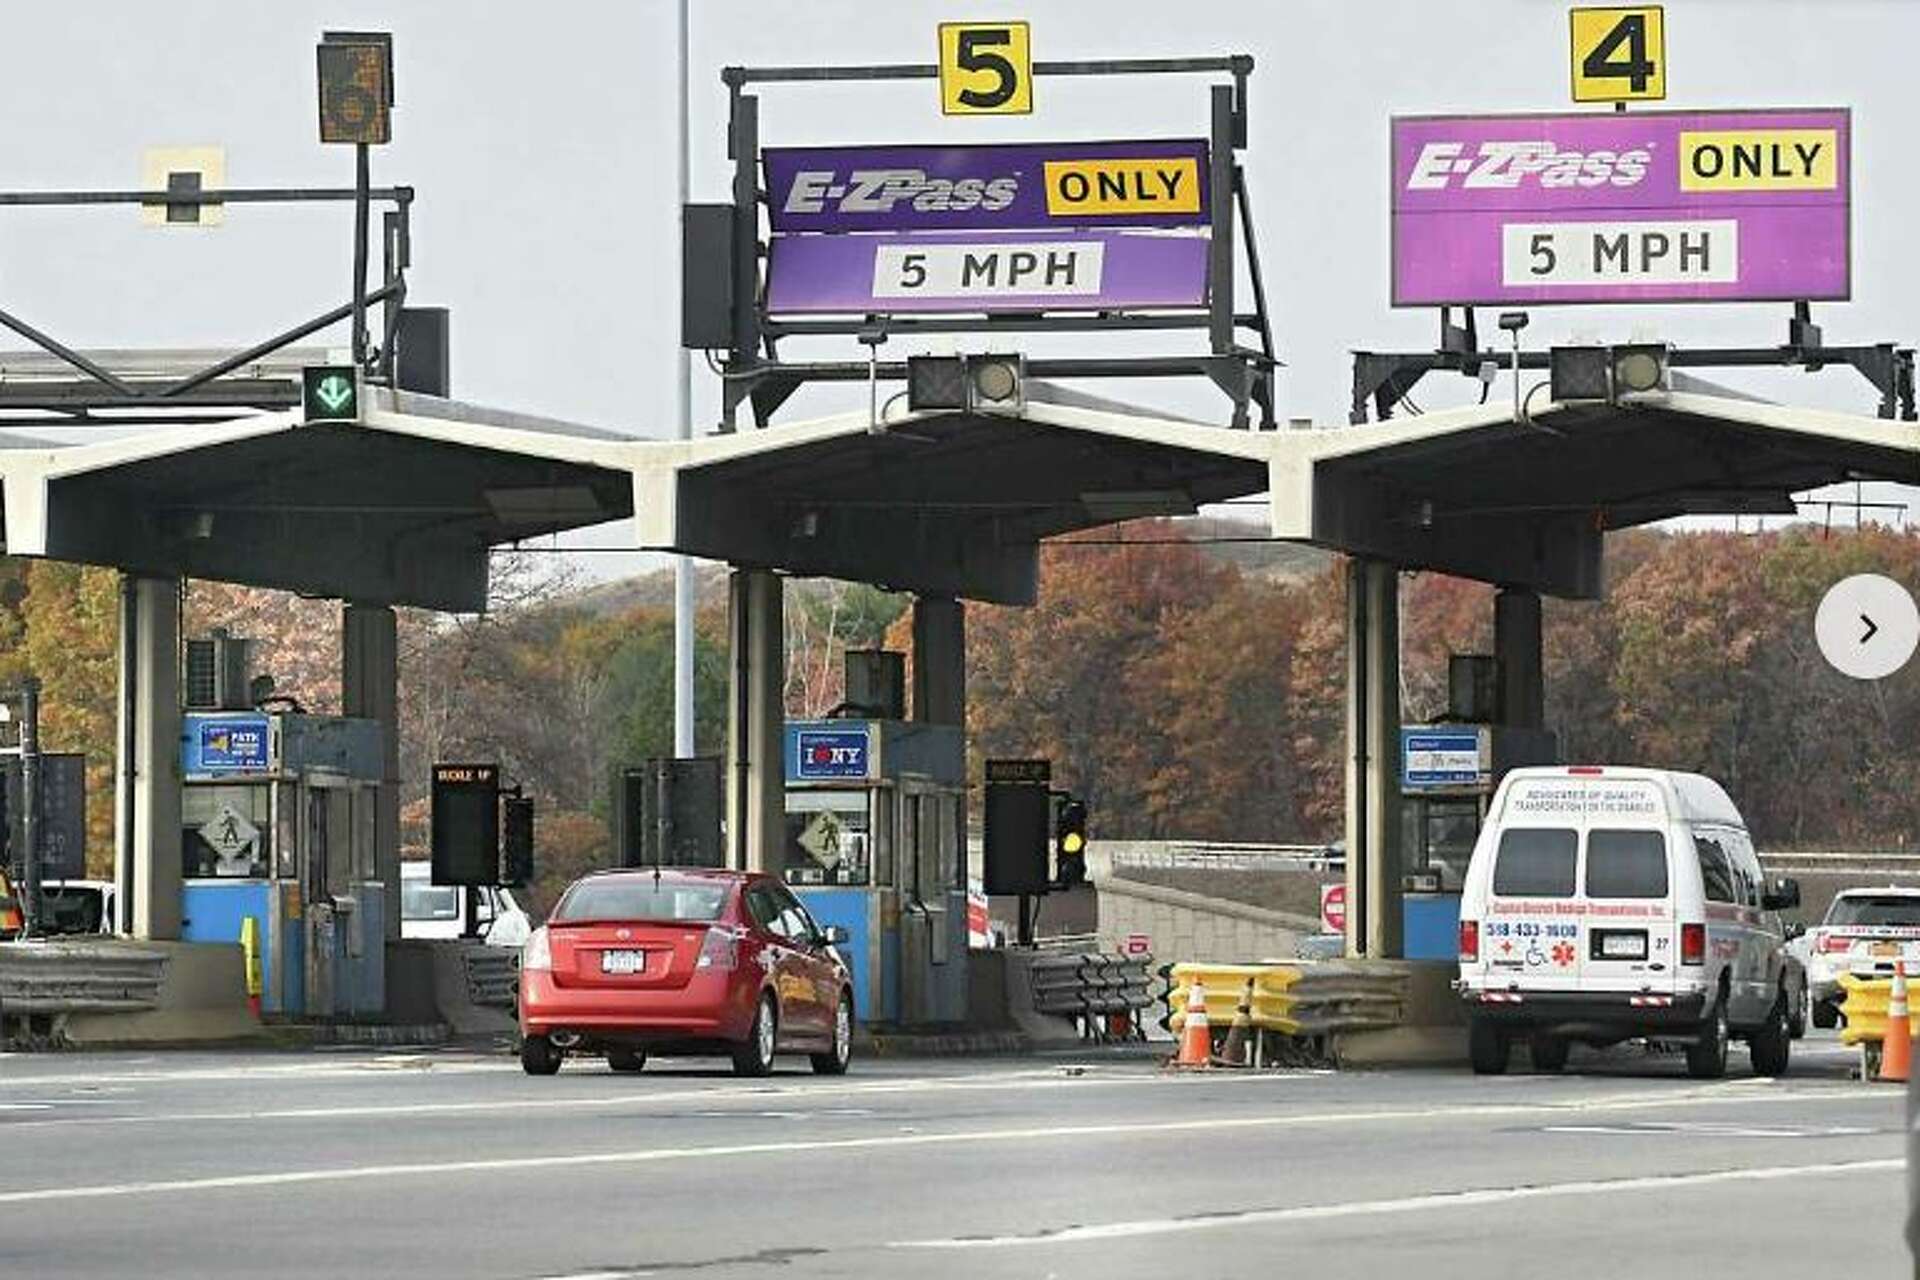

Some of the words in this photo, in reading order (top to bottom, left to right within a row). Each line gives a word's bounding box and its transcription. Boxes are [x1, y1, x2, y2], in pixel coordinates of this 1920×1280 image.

[957, 30, 1017, 108] 5
[1583, 15, 1655, 93] 4
[1407, 140, 1652, 190] E-ZPass
[1691, 143, 1823, 179] ONLY
[783, 168, 1019, 214] E-ZPass
[1058, 170, 1183, 203] ONLY
[899, 254, 927, 288] 5
[961, 251, 1077, 286] MPH
[1530, 234, 1557, 275] 5
[1593, 231, 1711, 273] MPH
